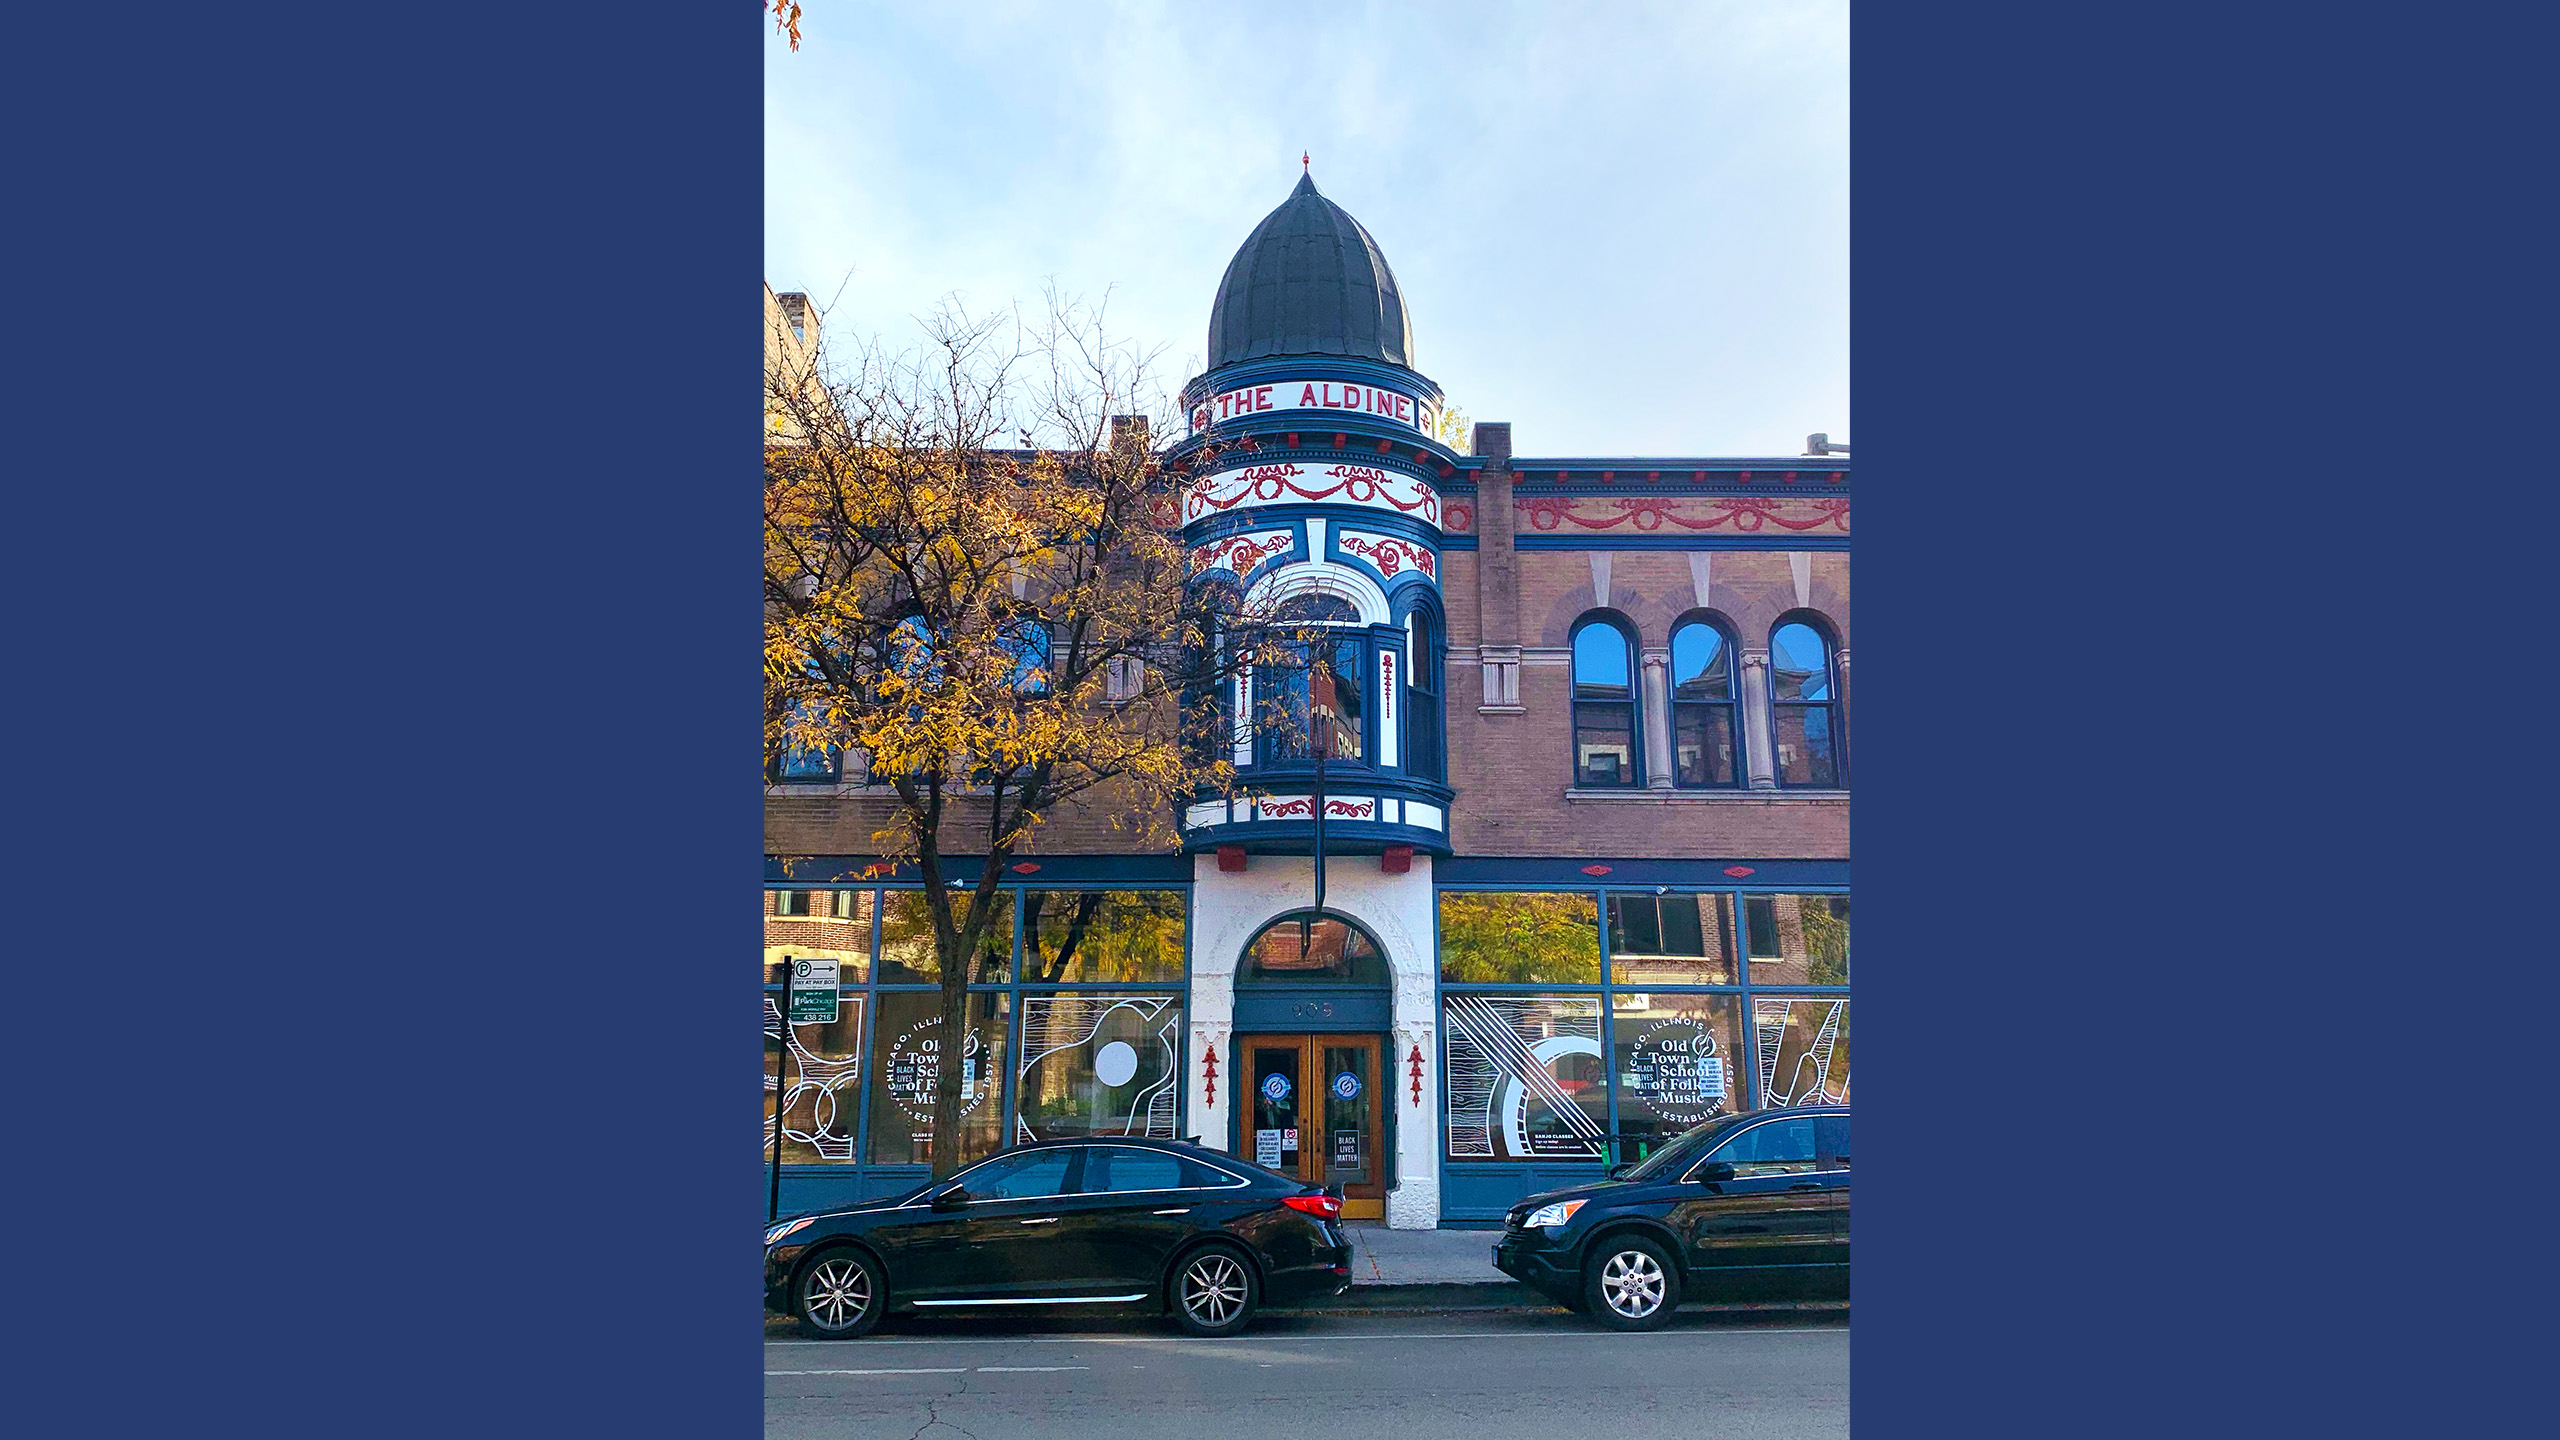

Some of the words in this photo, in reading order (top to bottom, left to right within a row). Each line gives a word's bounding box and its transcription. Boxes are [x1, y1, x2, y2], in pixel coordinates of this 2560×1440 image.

[1218, 386, 1273, 418] THE
[1299, 383, 1411, 421] ALDINE
[1650, 1017, 1704, 1032] ILLINOIS
[921, 1039, 940, 1052] Ol
[1661, 1039, 1688, 1052] Old
[906, 1052, 940, 1064] Tow
[1648, 1052, 1690, 1064] Town
[1660, 1064, 1710, 1077] School
[1725, 1063, 1734, 1088] 1957
[907, 1078, 923, 1091] of
[1651, 1078, 1668, 1091] of
[1670, 1078, 1702, 1091] Folk
[1659, 1091, 1705, 1104] Music
[1662, 1091, 1729, 1123] ESTABLISHED
[1338, 1136, 1356, 1144] BLACK
[1340, 1145, 1355, 1153] LIVES
[1337, 1154, 1358, 1162] MATTER
